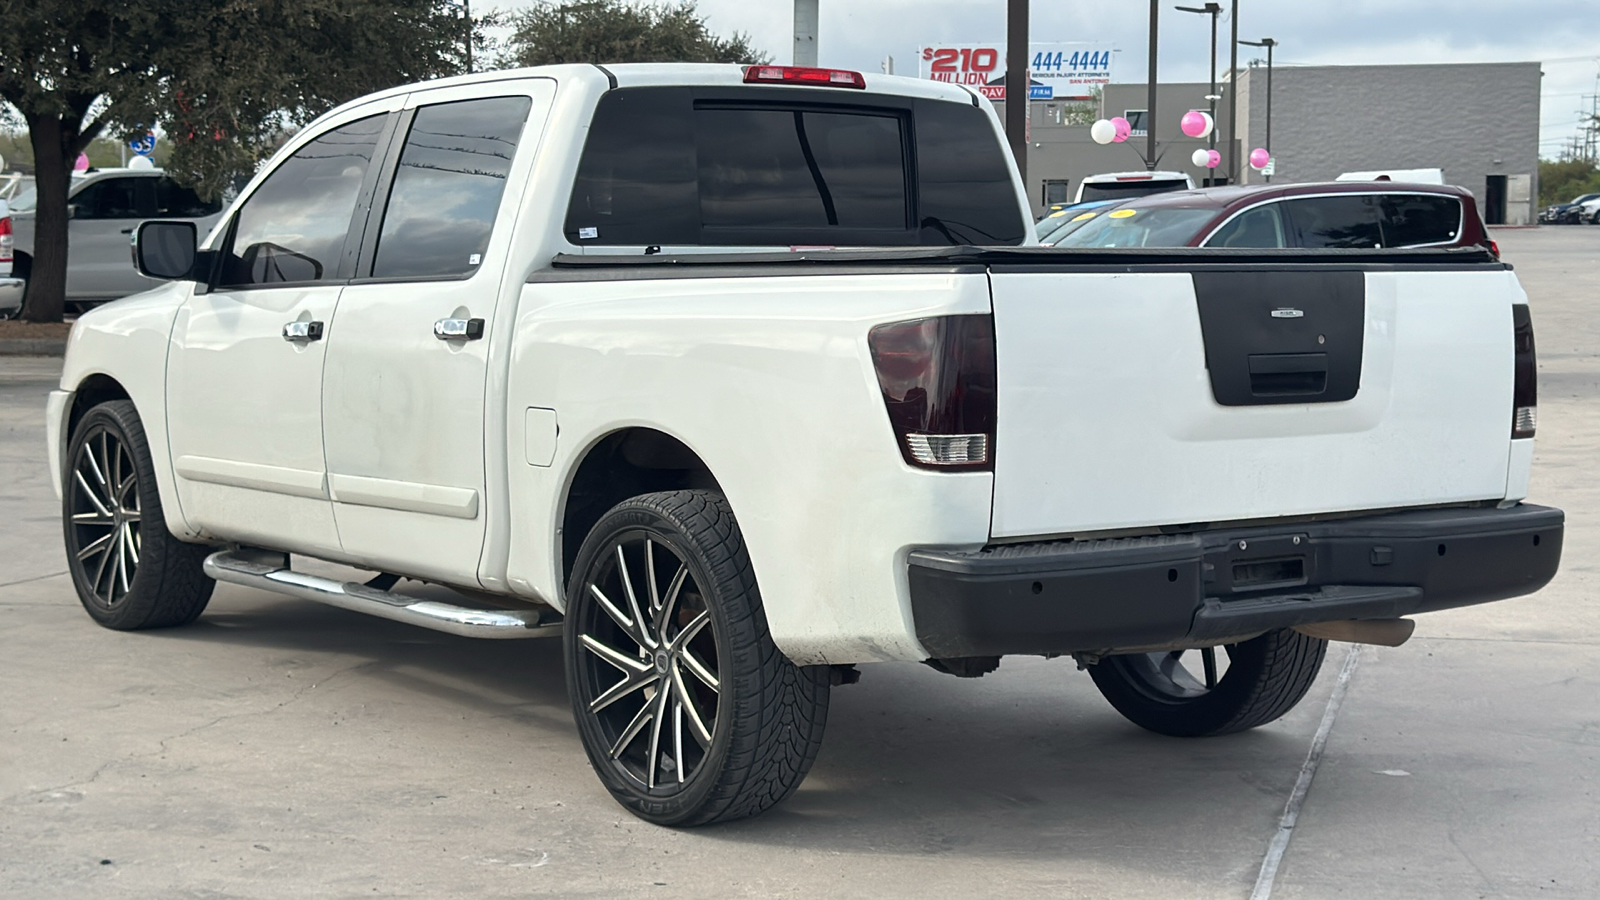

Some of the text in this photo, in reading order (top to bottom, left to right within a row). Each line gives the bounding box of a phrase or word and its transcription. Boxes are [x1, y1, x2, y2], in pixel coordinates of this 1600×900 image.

[923, 47, 998, 72] $210
[1032, 51, 1110, 71] 444-4444
[930, 72, 988, 85] MILLION
[980, 88, 1004, 97] DAV
